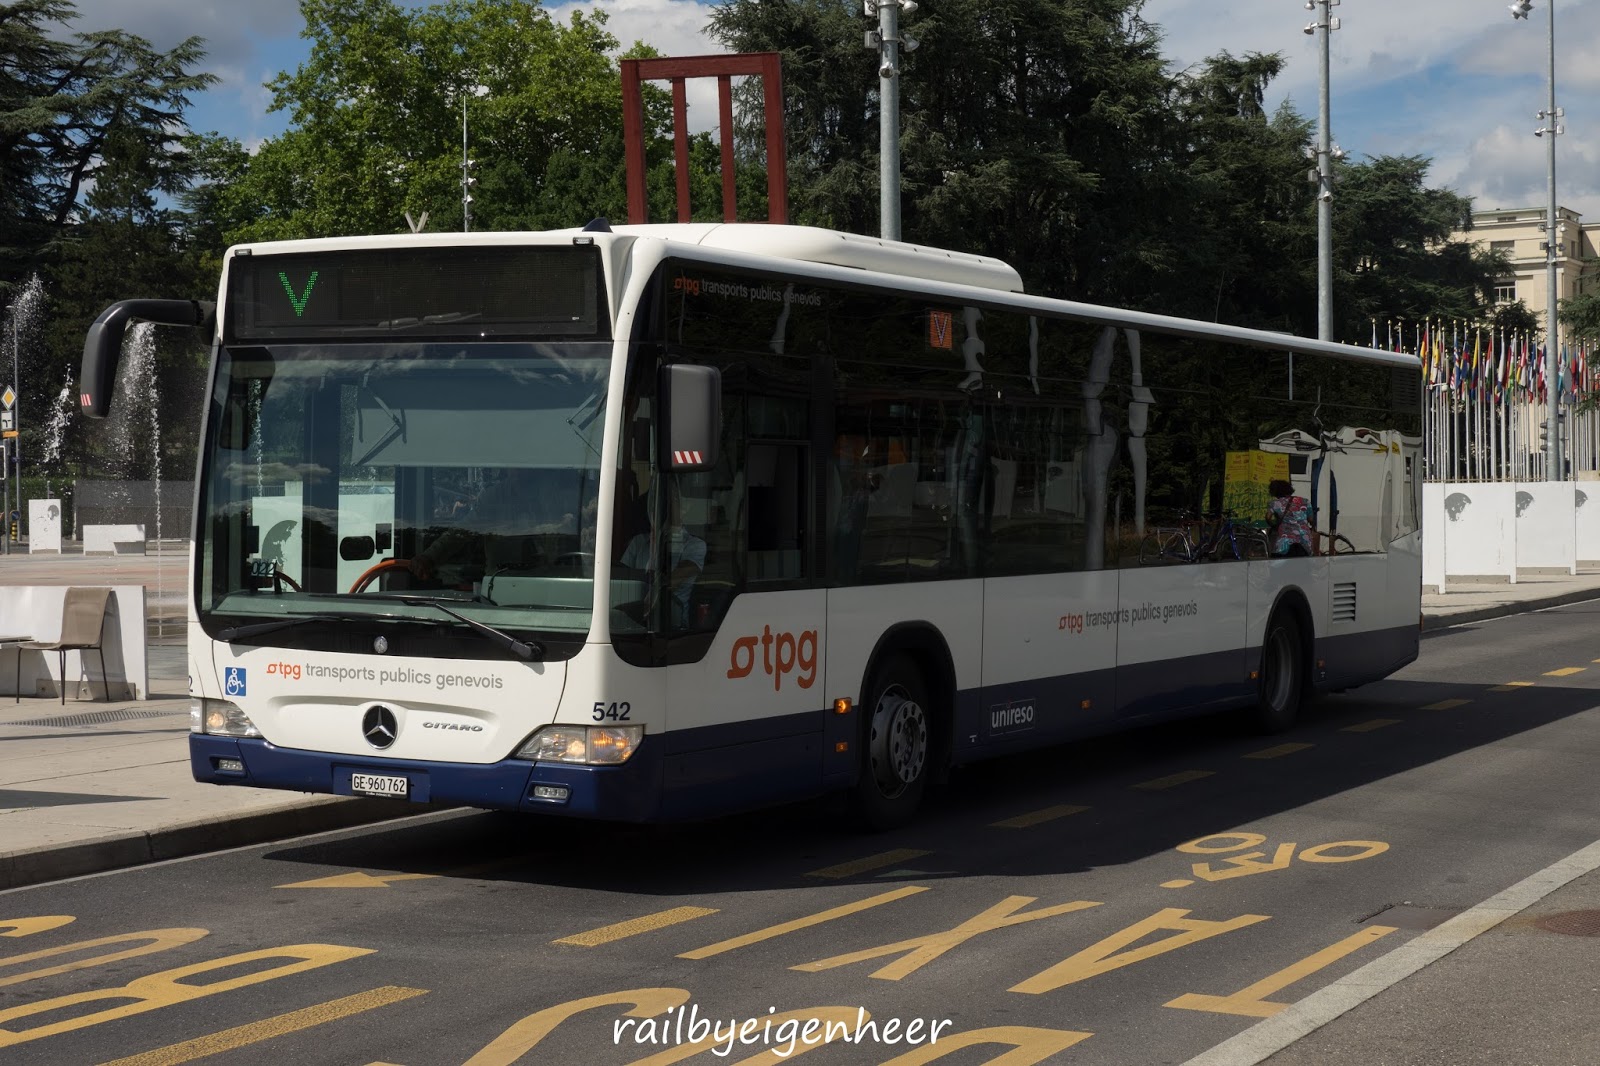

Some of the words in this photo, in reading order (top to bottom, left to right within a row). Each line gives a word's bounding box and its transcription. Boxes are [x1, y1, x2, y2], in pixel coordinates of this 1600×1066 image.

[278, 271, 319, 317] V
[702, 278, 749, 299] transports
[750, 285, 782, 302] publics
[784, 290, 821, 306] genevois
[933, 312, 949, 347] V
[1086, 608, 1130, 630] transports
[1131, 602, 1161, 627] publics
[1163, 600, 1198, 624] genevois
[305, 663, 376, 682] transports
[379, 667, 432, 686] publics
[436, 674, 503, 691] genevois
[592, 701, 631, 722] 542
[991, 704, 1034, 729] unireso
[422, 721, 483, 732] CITARO
